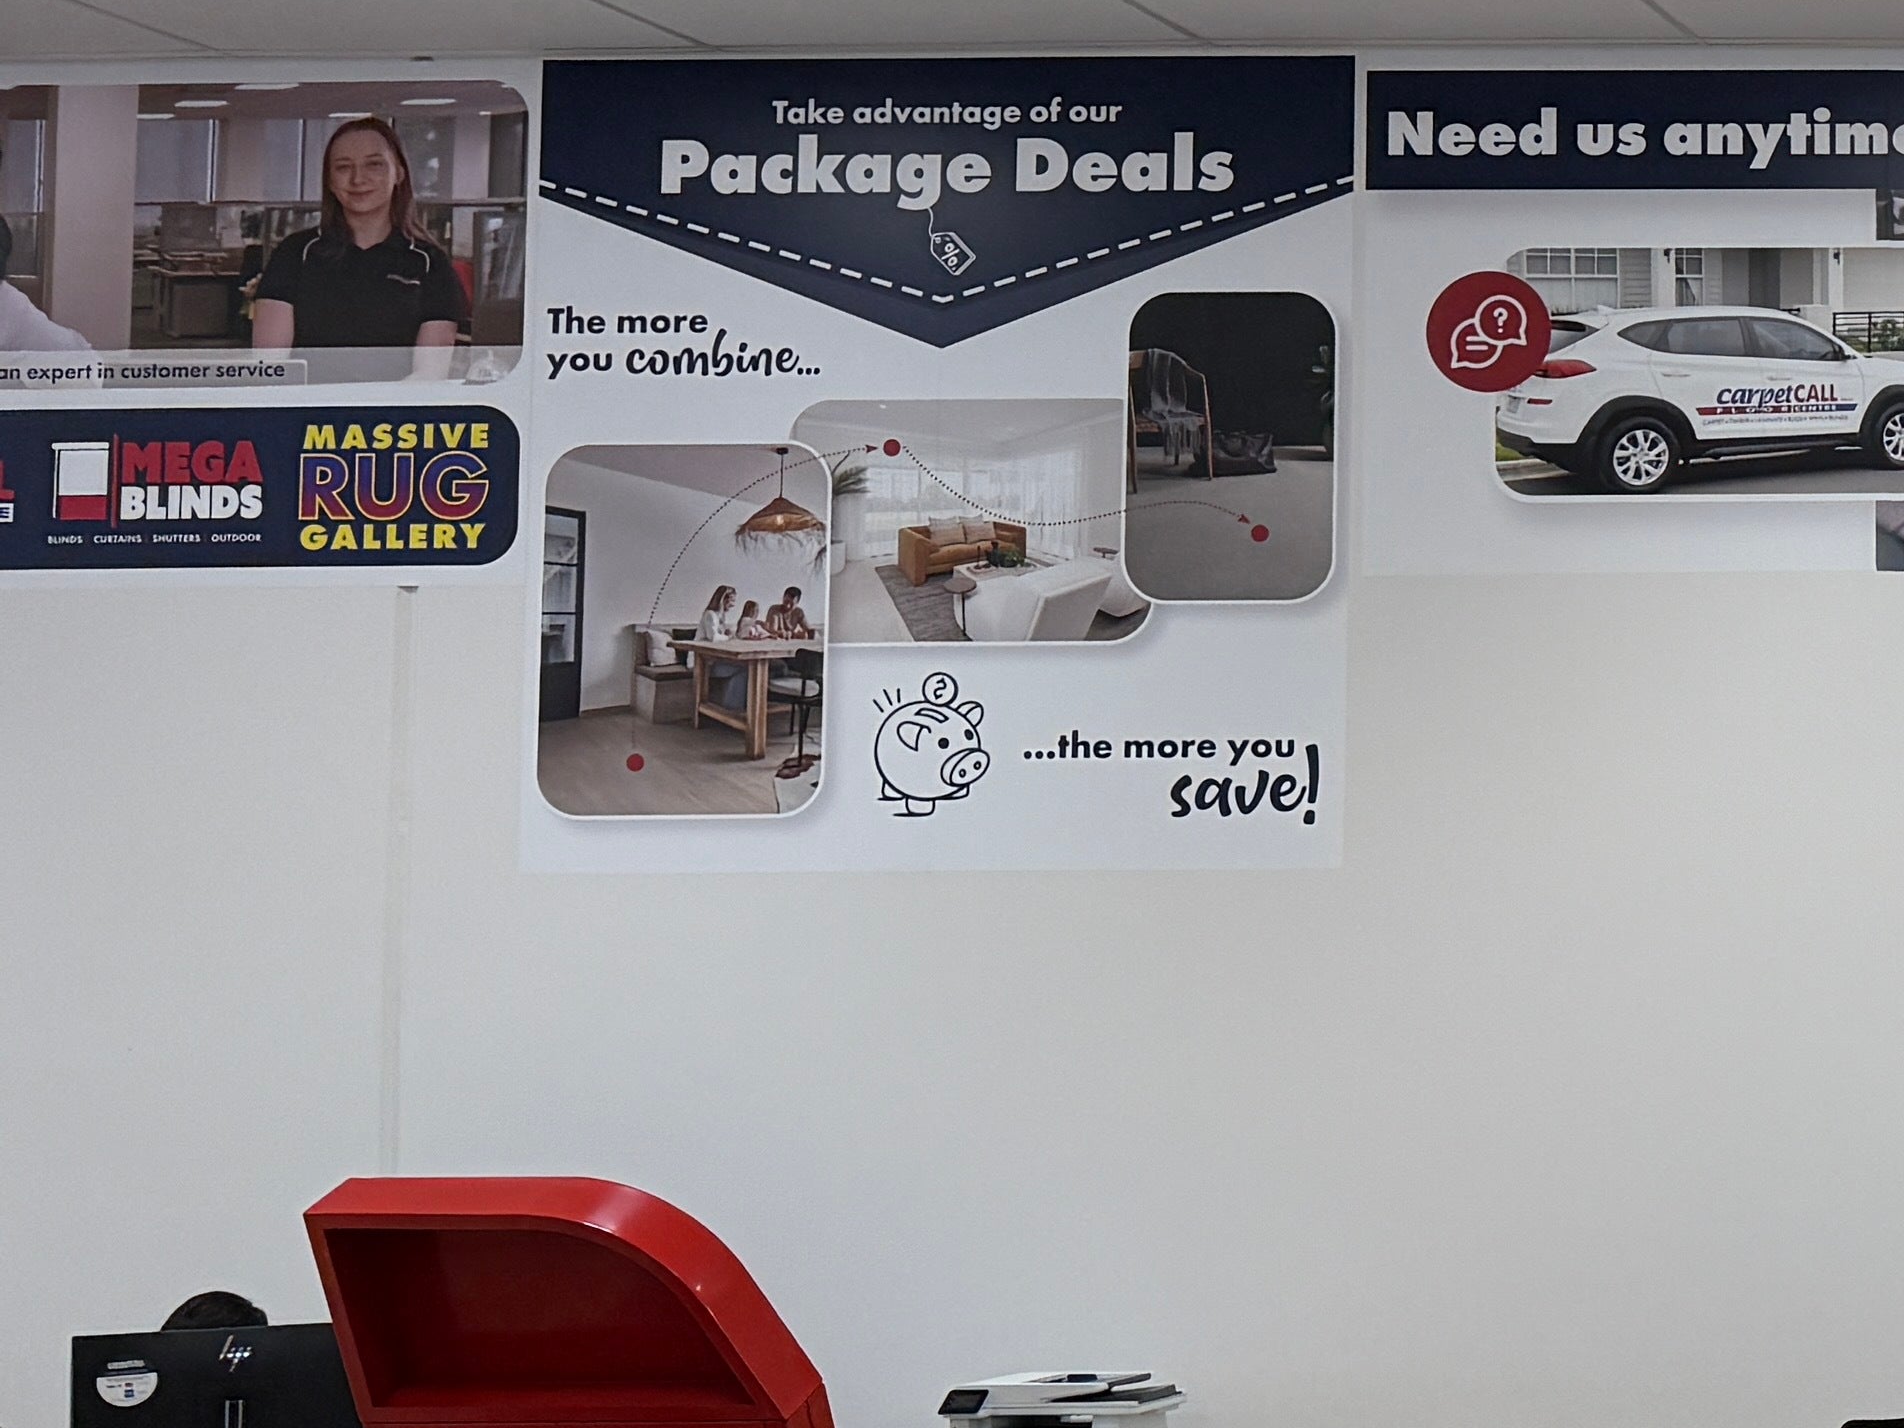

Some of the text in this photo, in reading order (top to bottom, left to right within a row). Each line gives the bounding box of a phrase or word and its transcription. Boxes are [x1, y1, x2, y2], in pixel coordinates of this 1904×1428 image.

[772, 97, 1122, 131] Take advantage of our
[1387, 108, 1559, 157] Need
[1576, 122, 1647, 156] us
[660, 131, 1235, 210] Package Deals
[548, 307, 709, 335] The more
[27, 363, 92, 383] expert
[97, 362, 114, 379] in
[121, 364, 210, 379] customer
[216, 361, 285, 377] service
[546, 349, 613, 379] you
[304, 423, 489, 450] MASSIVE
[121, 440, 263, 484] MEGA
[120, 484, 263, 520] BLINDS
[298, 451, 489, 521] RUG
[211, 533, 261, 542] OUTDOOR
[300, 523, 485, 551] GALLERY
[1124, 736, 1217, 759] more
[1226, 736, 1296, 766] you
[1170, 745, 1321, 825] save!
